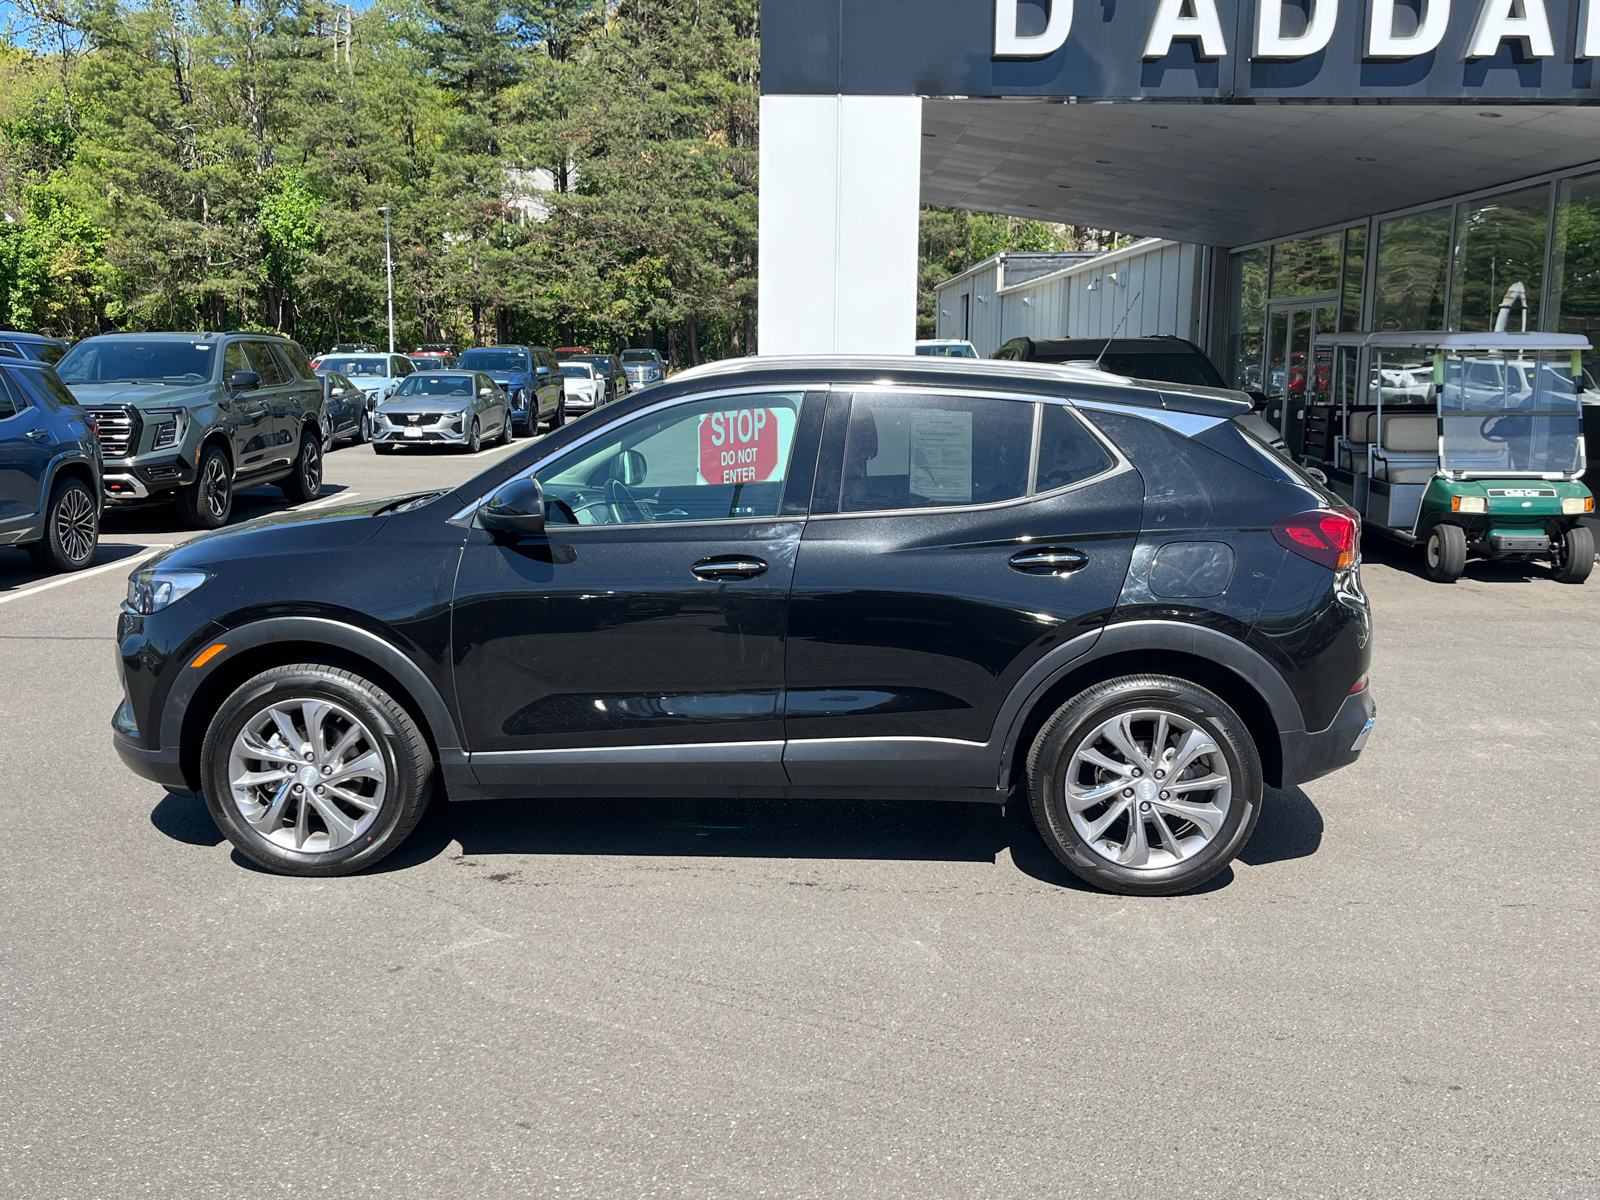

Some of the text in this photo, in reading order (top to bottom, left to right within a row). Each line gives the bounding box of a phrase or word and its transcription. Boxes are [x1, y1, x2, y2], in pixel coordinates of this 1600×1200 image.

[711, 408, 766, 446] STOP
[721, 447, 758, 466] DO NOT
[723, 466, 756, 484] ENTER
